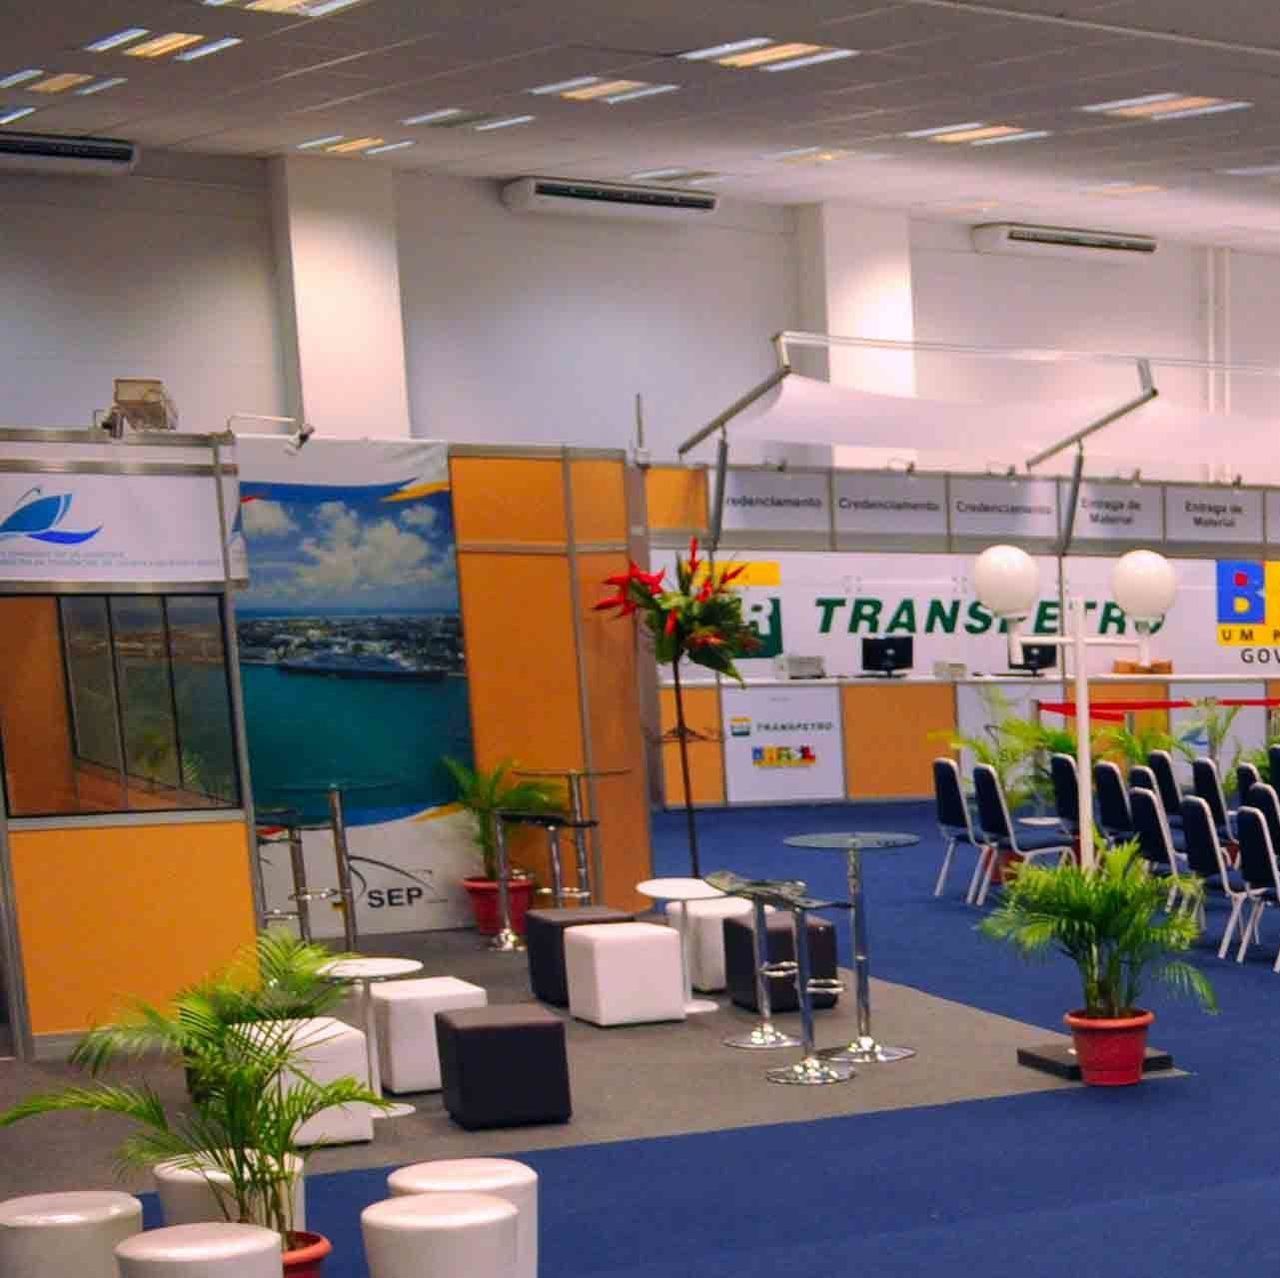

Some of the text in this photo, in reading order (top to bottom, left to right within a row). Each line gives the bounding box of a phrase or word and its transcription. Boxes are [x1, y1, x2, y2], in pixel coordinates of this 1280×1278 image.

[727, 495, 822, 508] redenciamento
[838, 497, 941, 511] Credenciamento
[814, 598, 1165, 634] TRANSER
[1222, 629, 1255, 641] UM
[367, 886, 424, 909] SEP
